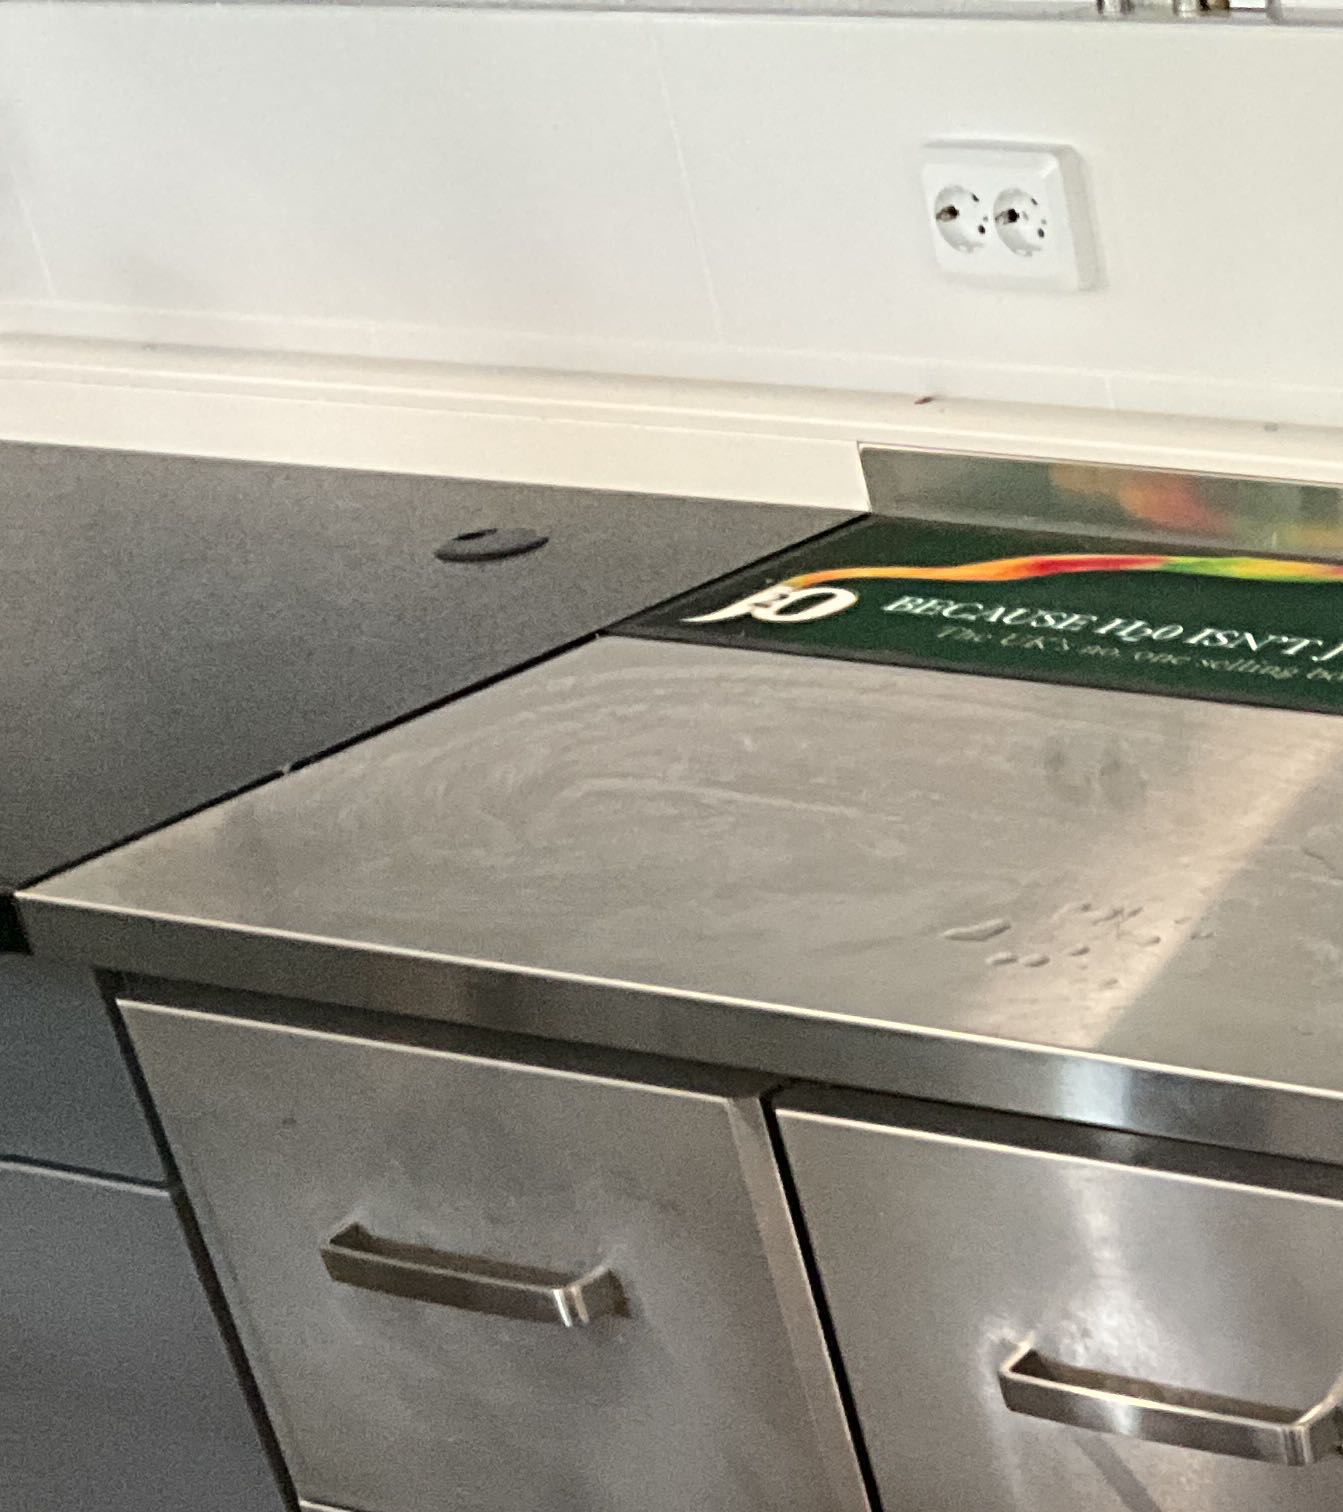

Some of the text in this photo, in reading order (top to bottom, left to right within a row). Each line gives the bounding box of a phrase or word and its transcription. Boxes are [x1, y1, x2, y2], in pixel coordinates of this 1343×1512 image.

[881, 595, 1098, 631] BECAUSE
[1183, 628, 1324, 655] ISN'T
[1198, 658, 1300, 680] selling
